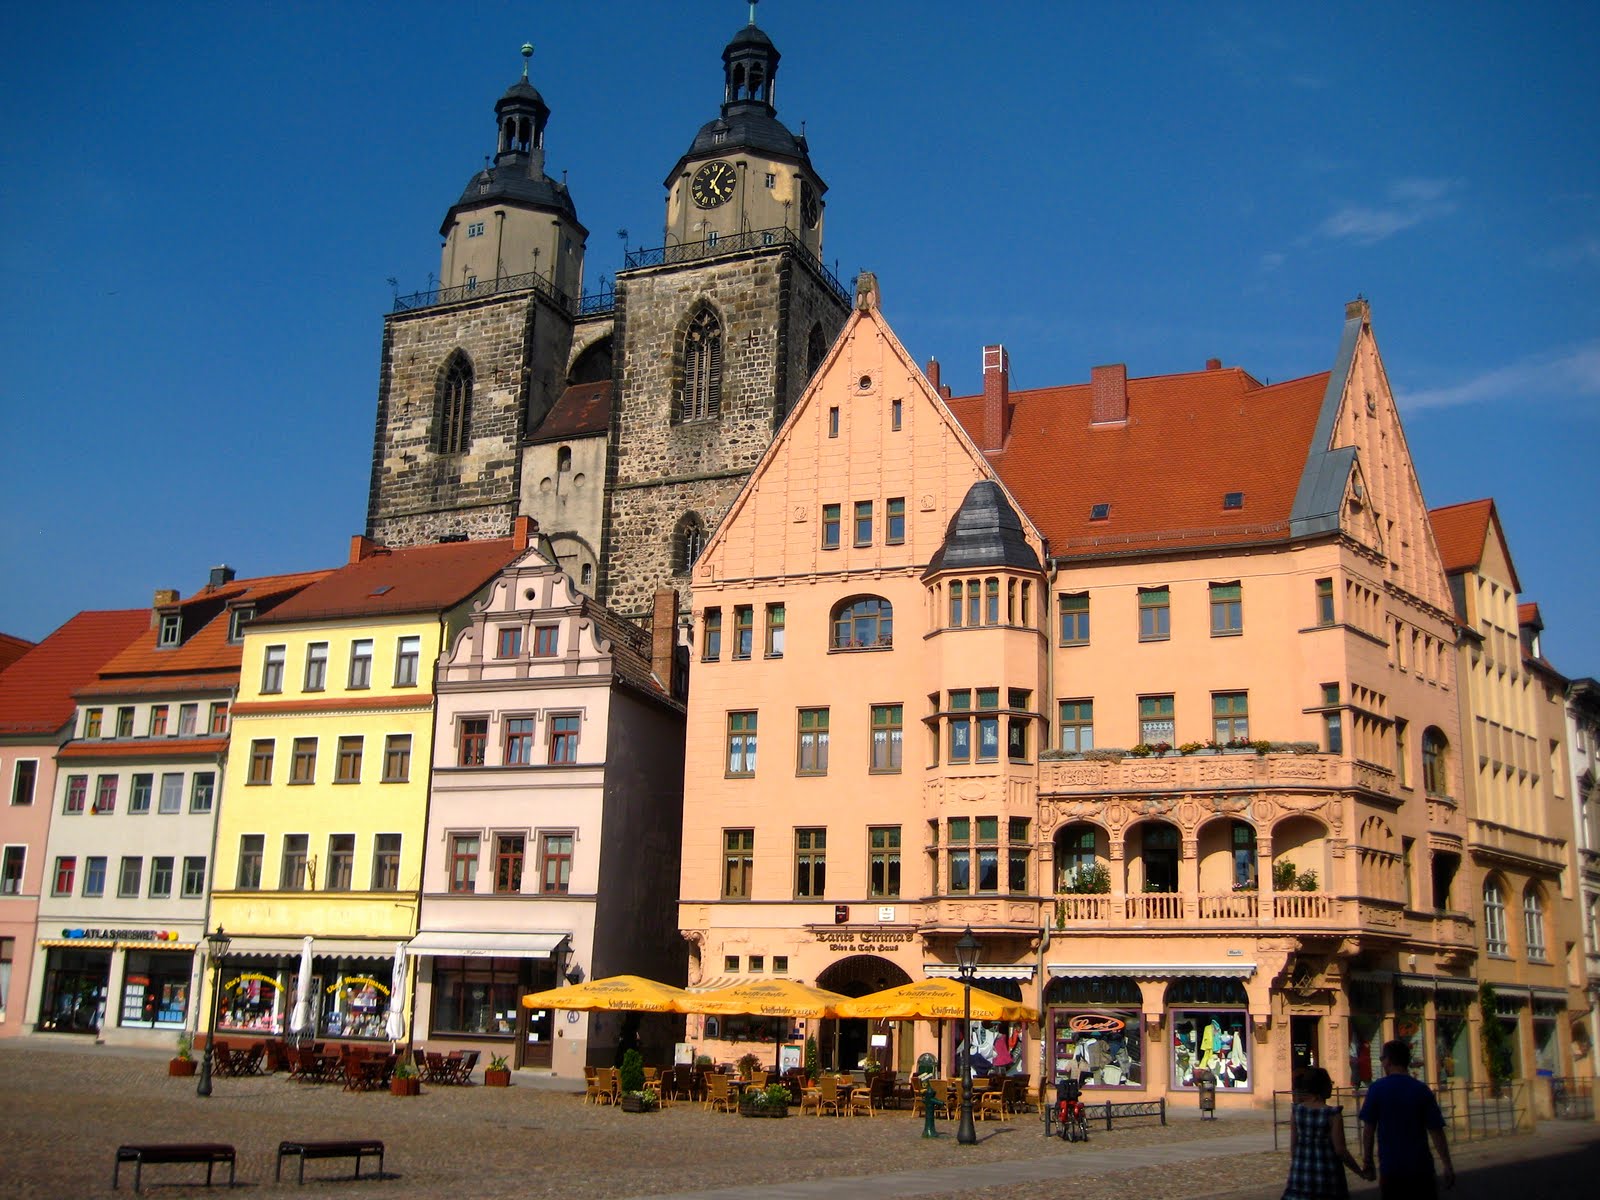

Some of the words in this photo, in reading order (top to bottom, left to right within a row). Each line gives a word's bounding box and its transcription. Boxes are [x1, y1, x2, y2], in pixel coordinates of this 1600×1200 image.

[84, 928, 115, 940] ATLAS
[816, 932, 855, 943] Tante
[849, 944, 856, 952] &
